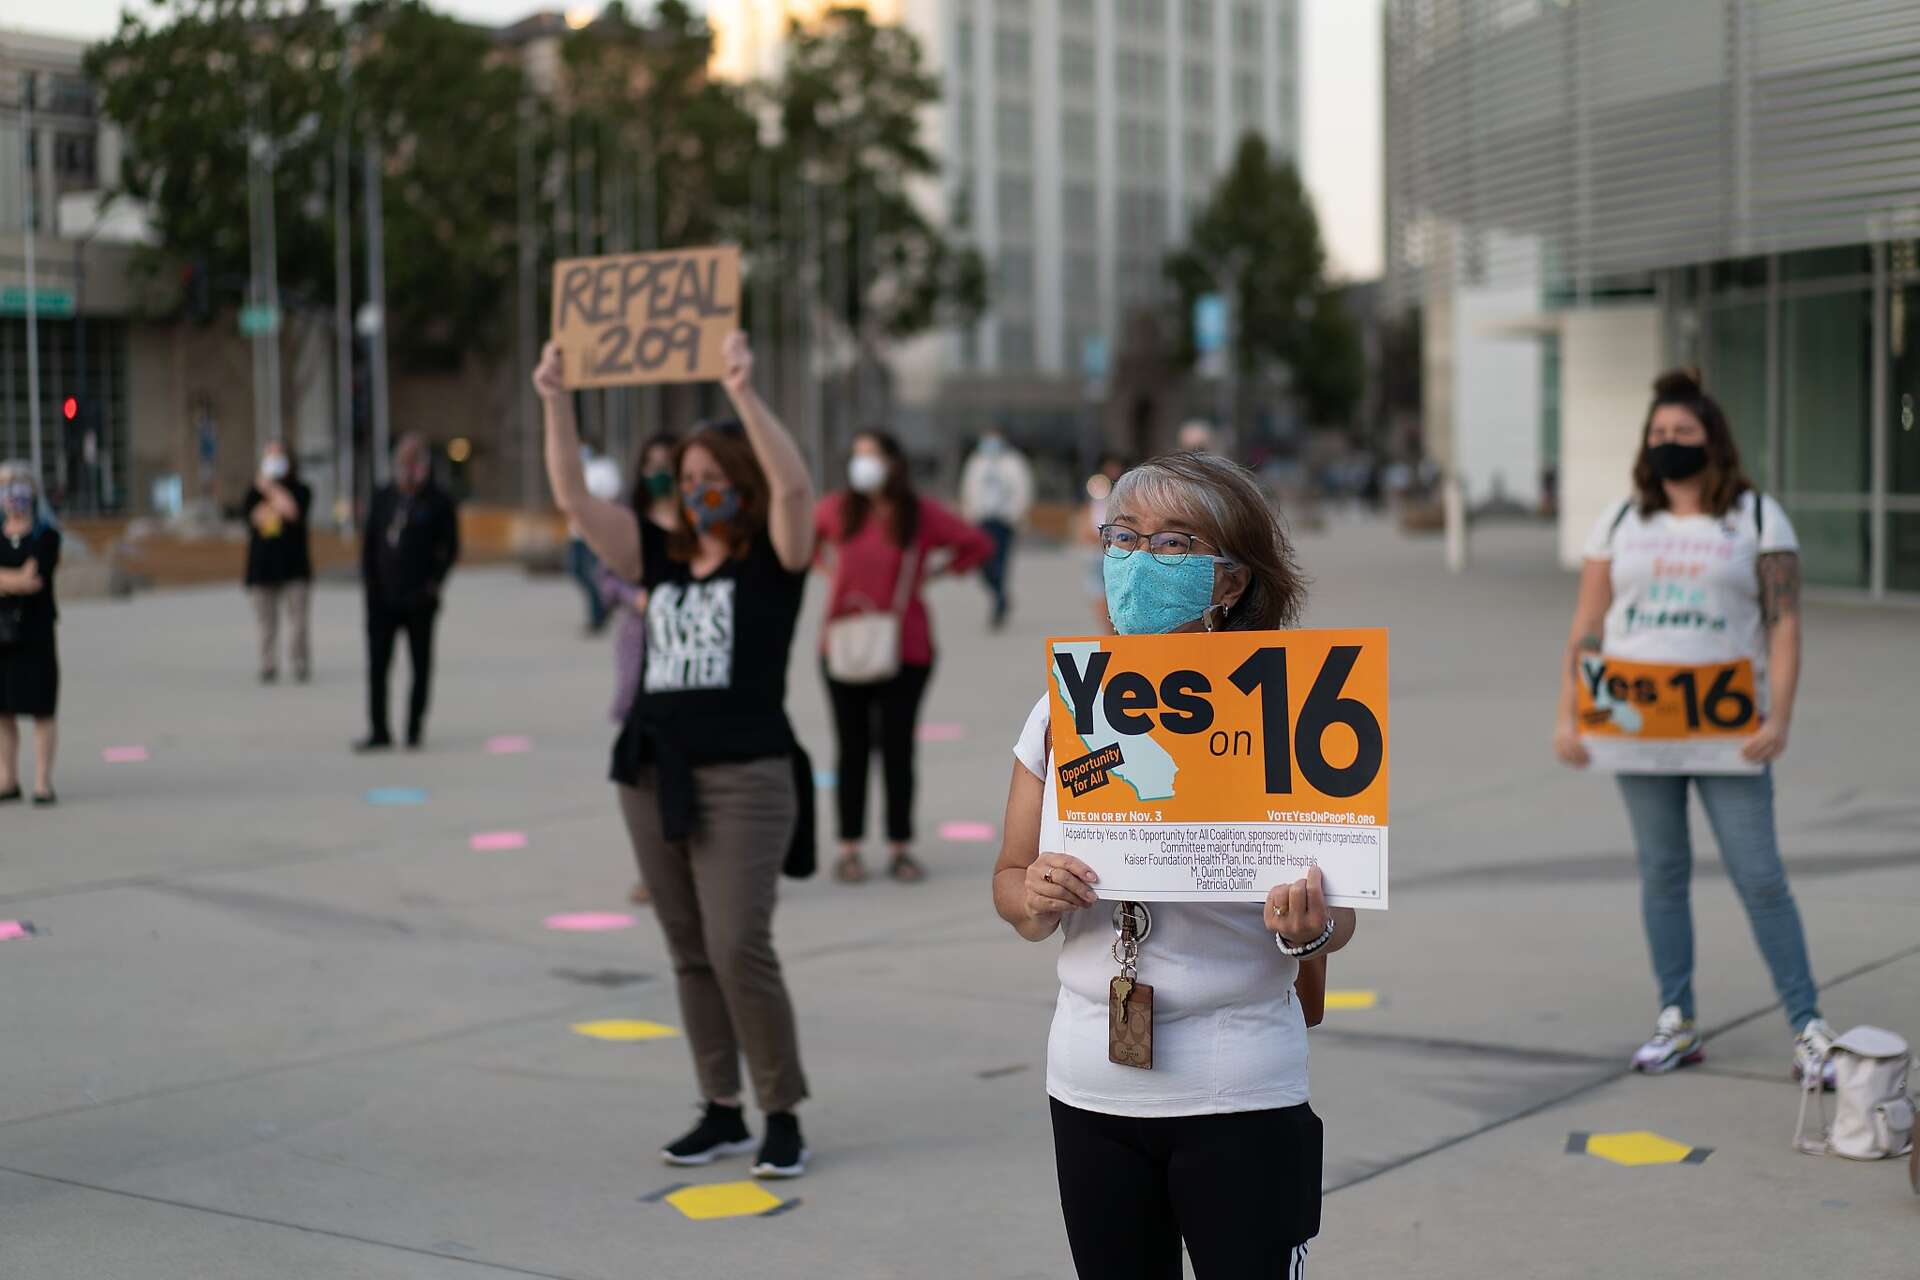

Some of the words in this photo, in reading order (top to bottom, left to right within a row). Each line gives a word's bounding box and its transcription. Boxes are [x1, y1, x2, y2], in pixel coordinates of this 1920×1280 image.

[559, 257, 735, 330] REPEAL
[593, 319, 700, 374] 209
[1054, 652, 1215, 735] Yes
[1583, 659, 1658, 704] Yes
[1668, 666, 1755, 731] 16
[1227, 645, 1384, 798] 16
[1209, 730, 1252, 756] on
[1061, 748, 1120, 783] Opportunity
[1073, 779, 1089, 793] for
[1090, 769, 1104, 787] All
[1155, 811, 1162, 822] 3
[1096, 828, 1104, 843] by
[1105, 829, 1118, 840] Yes
[1118, 832, 1128, 840] on
[1128, 829, 1139, 842] 16,
[1139, 829, 1185, 843] Opportunity
[1187, 829, 1197, 840] for
[1199, 829, 1209, 840] All
[1209, 829, 1246, 842] Coalition,
[1248, 830, 1289, 843] sponsored
[1289, 830, 1298, 844] by
[1299, 830, 1312, 841] civil
[1312, 832, 1331, 845] rights
[1160, 841, 1206, 853] Committee
[1207, 842, 1230, 855] major
[1231, 842, 1261, 855] funding
[1261, 842, 1284, 853] from:
[1124, 853, 1148, 865] Kaiser
[1148, 854, 1194, 865] Foundation
[1194, 853, 1221, 865] Health
[1242, 854, 1257, 865] Inc.
[1257, 854, 1273, 865] and
[1273, 854, 1285, 865] the
[1190, 866, 1200, 877] M.
[1201, 866, 1225, 879] Quinn
[1225, 866, 1258, 879] Delaney
[1196, 878, 1228, 890] Patricia
[1228, 878, 1253, 891] Quillin
